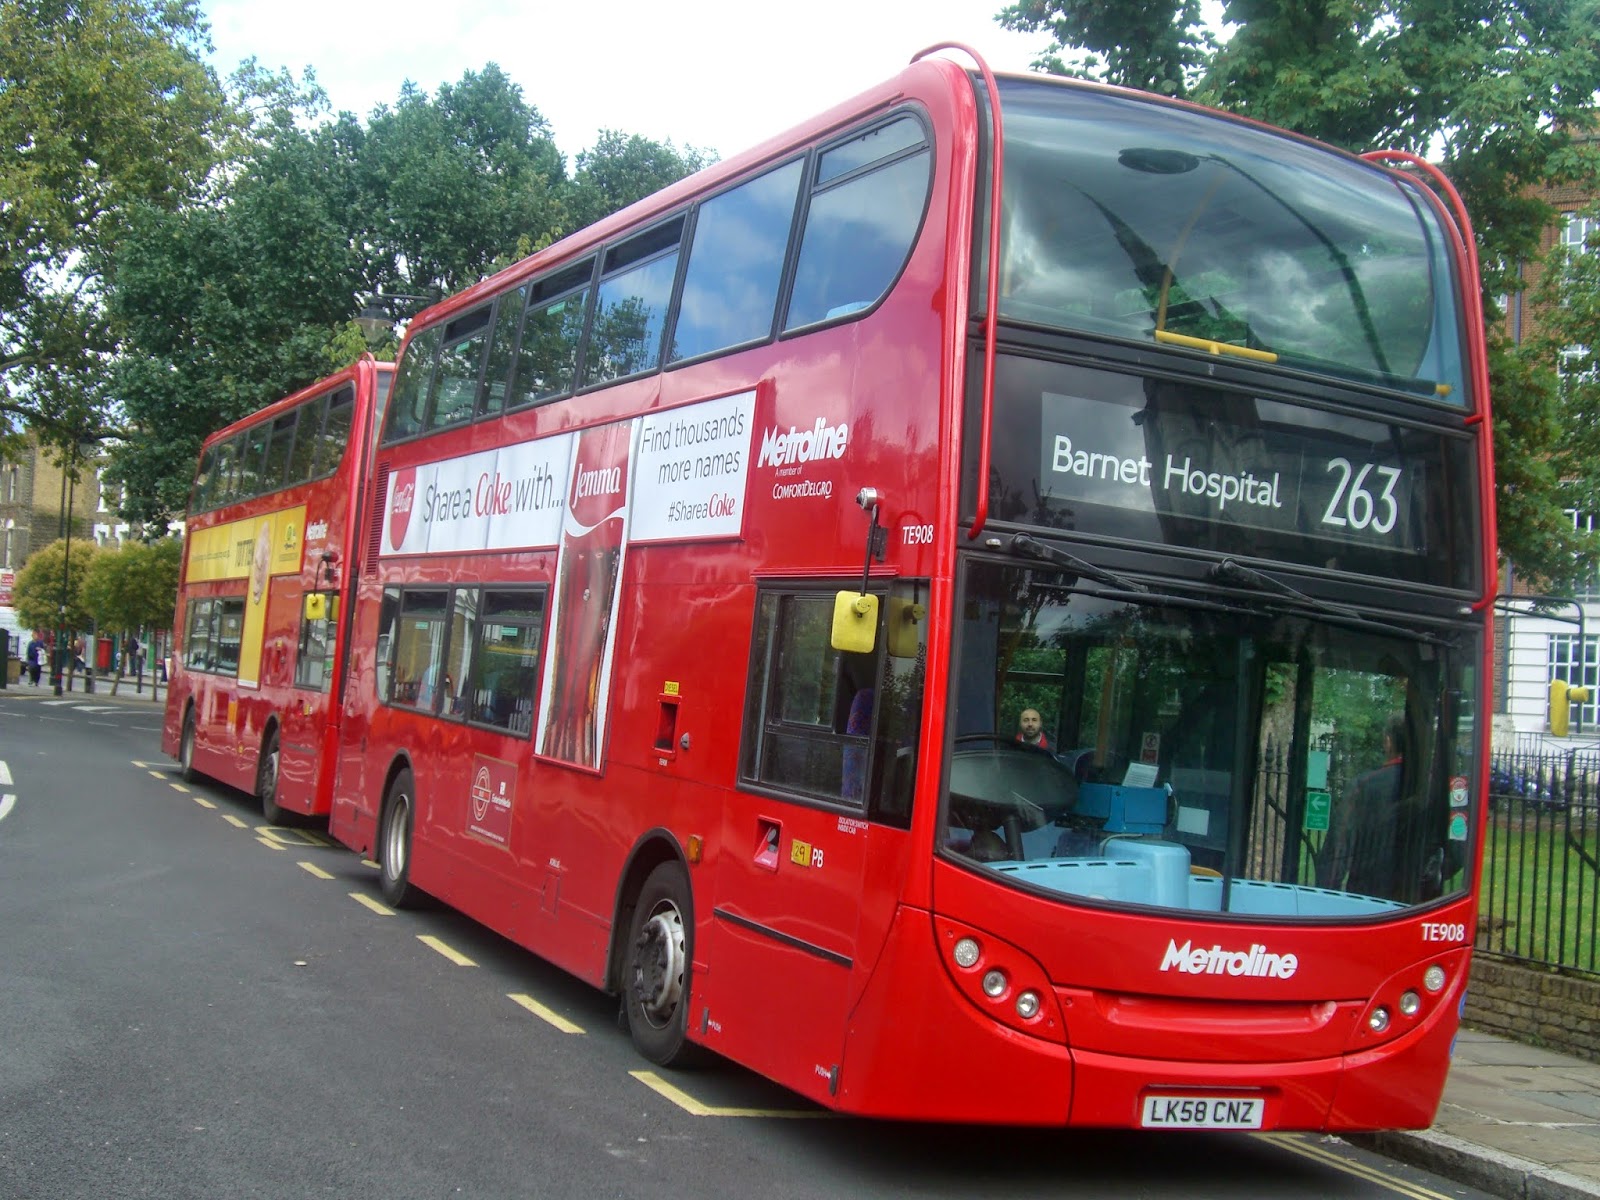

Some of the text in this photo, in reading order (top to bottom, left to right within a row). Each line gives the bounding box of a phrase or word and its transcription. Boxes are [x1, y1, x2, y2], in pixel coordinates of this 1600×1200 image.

[642, 407, 745, 453] Find thousands
[757, 417, 848, 467] Metroline
[572, 463, 621, 509] Jemma
[658, 451, 741, 484] more names
[780, 467, 797, 476] member
[1052, 435, 1282, 510] Barnet Hospital
[423, 462, 564, 523] Share a Coke with...
[1322, 457, 1402, 533] 263
[902, 525, 934, 545] TE908
[795, 845, 824, 868] 29 PB
[1421, 923, 1465, 942] TE908
[1160, 938, 1298, 979] Metroline
[1150, 1100, 1255, 1123] LK58 CNZ
